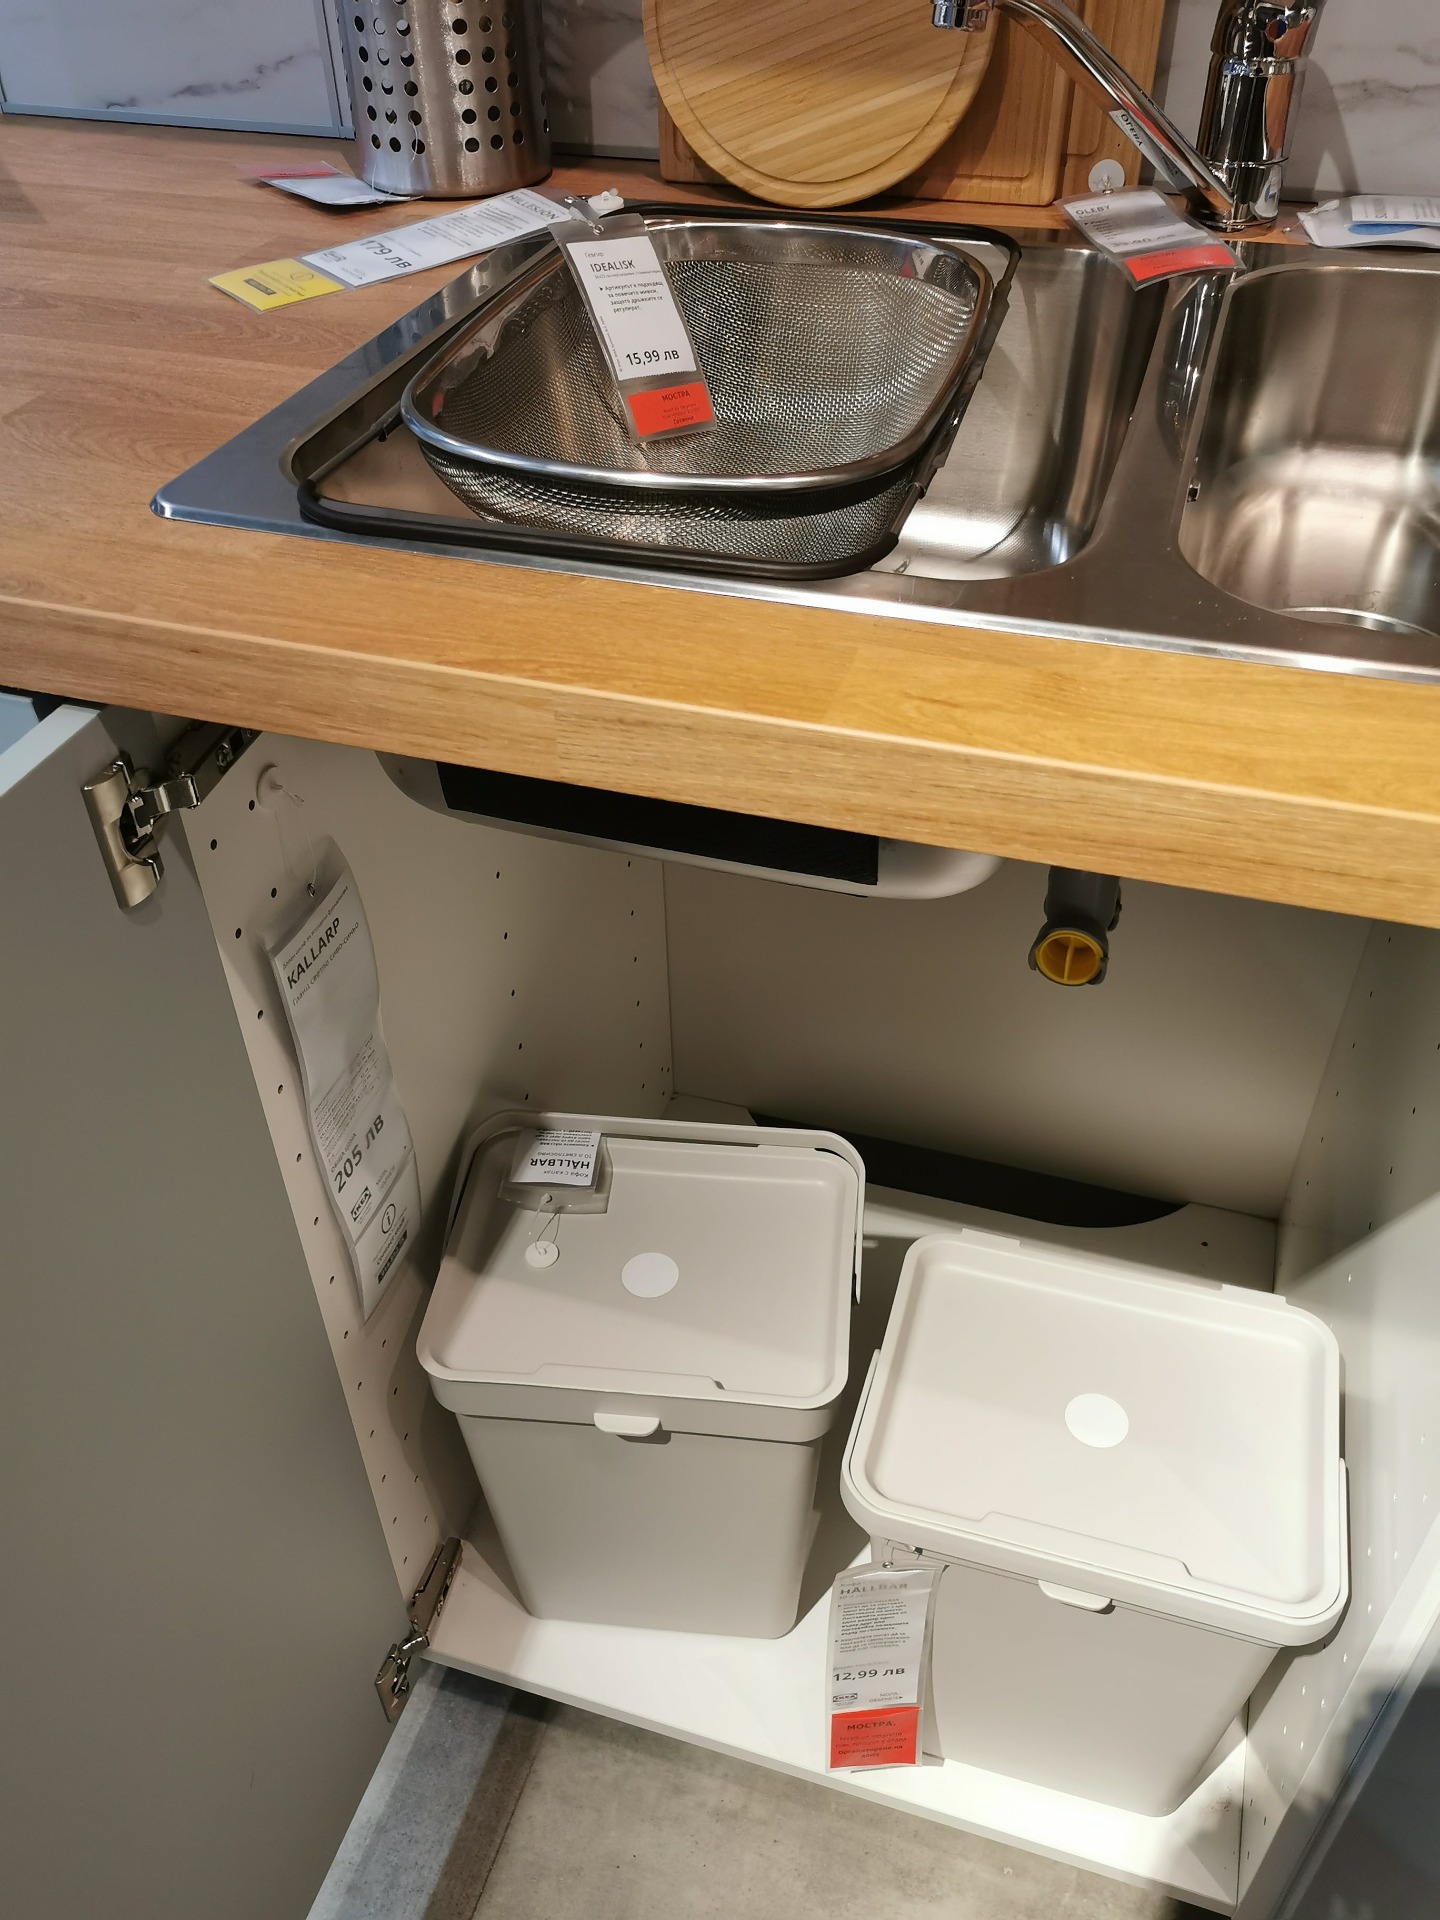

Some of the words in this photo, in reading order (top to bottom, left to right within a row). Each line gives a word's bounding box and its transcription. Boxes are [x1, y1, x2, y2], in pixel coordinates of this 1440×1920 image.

[1076, 205, 1110, 215] OLEBY
[360, 240, 392, 255] 179
[590, 260, 636, 272] IDEALISK
[626, 350, 660, 366] 15,99
[662, 391, 690, 402] МОСТРА
[287, 917, 340, 989] KALLARP
[334, 1144, 362, 1194] 205
[530, 1158, 590, 1169] HÅLLBAR
[352, 1190, 371, 1220] IKEA
[833, 1669, 878, 1681] 12,99
[847, 1721, 896, 1730] МОСТРА.
